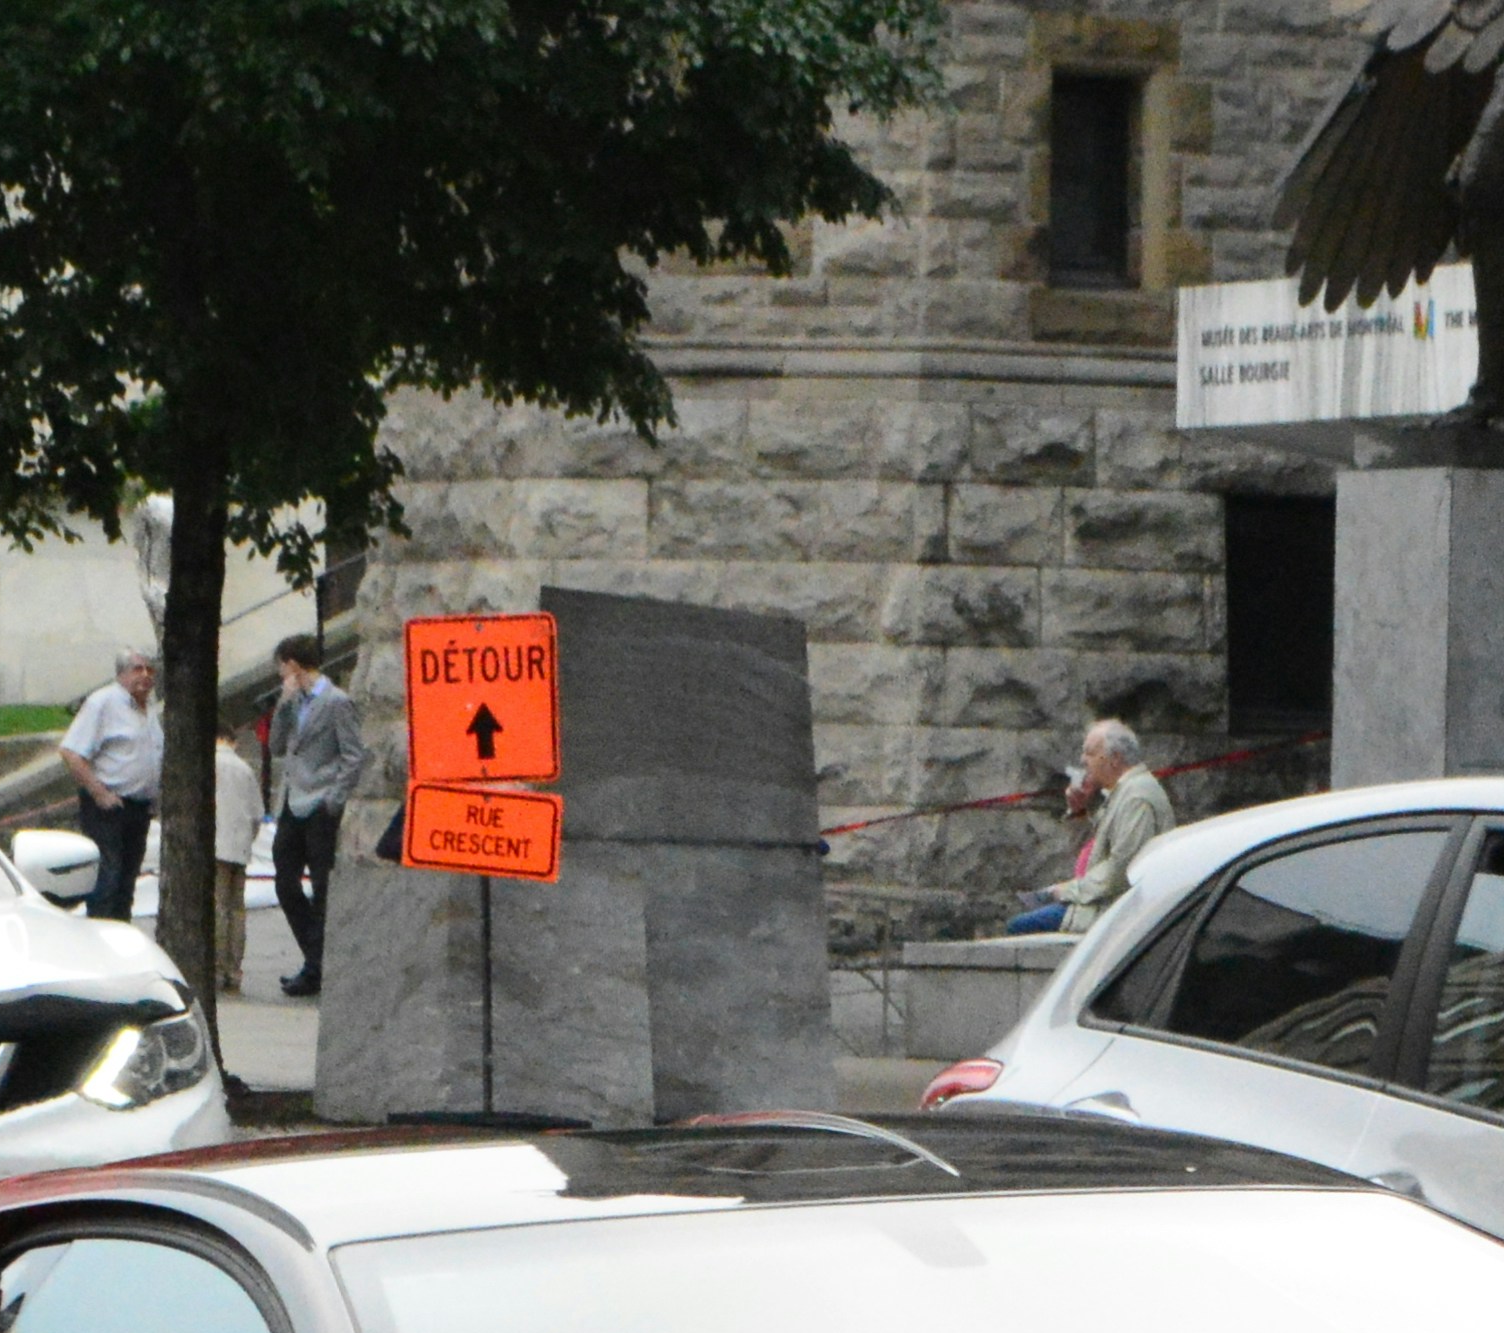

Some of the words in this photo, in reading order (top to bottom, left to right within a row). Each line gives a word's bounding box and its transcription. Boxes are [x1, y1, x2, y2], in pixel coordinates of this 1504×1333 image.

[1239, 325, 1258, 347] DES
[1329, 319, 1343, 340] DE
[1445, 310, 1464, 329] THE
[1200, 363, 1234, 387] SALLE
[420, 639, 545, 685] DÉTOUR
[465, 803, 505, 829] RUE
[429, 829, 533, 859] CRESCENT
